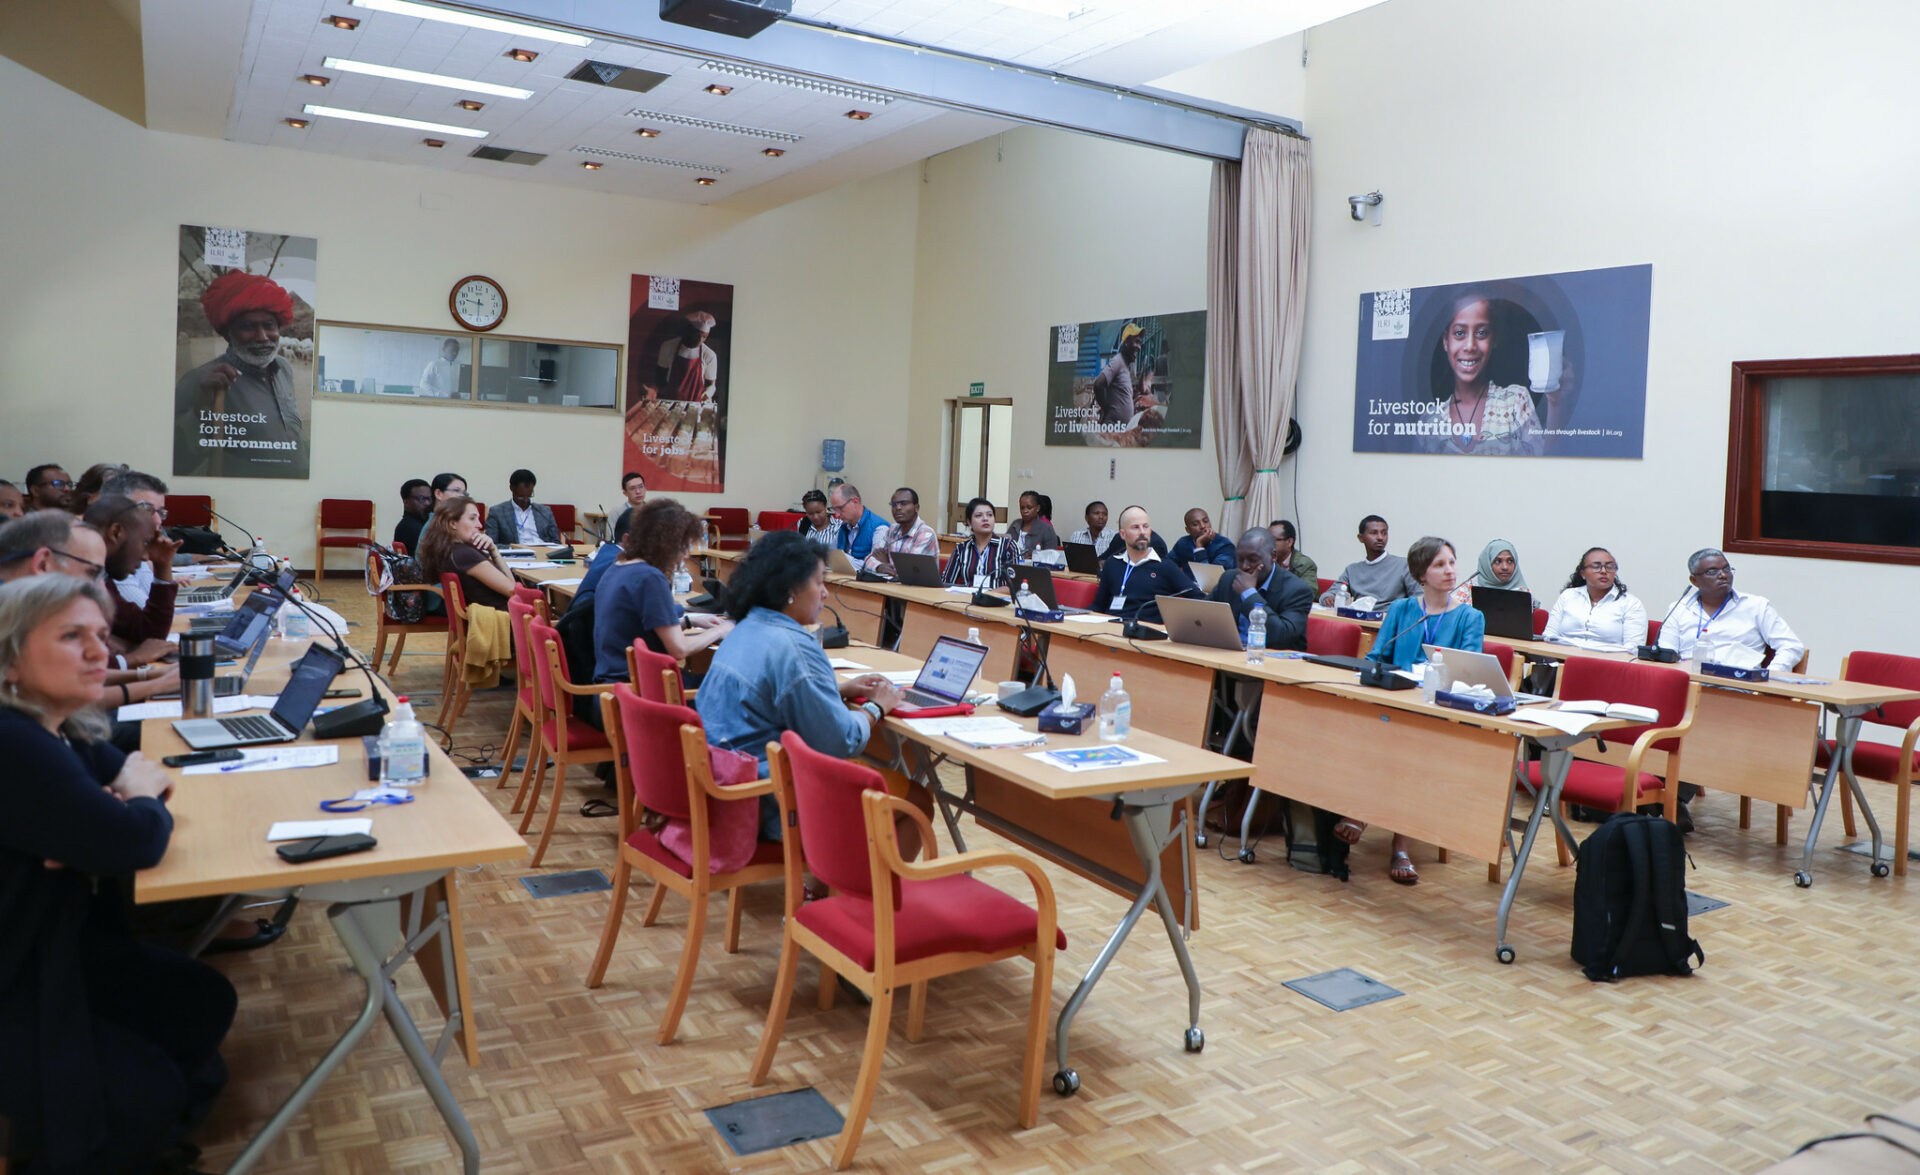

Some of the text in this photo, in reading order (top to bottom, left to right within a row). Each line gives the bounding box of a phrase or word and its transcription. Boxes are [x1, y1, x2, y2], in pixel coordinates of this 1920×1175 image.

[1376, 319, 1391, 328] ILRI
[1368, 398, 1447, 415] Livestock
[200, 410, 267, 423] Livestock
[199, 423, 248, 435] for the
[1054, 420, 1067, 433] for
[1068, 420, 1127, 433] livelihoods
[1367, 418, 1477, 436] for nutrition
[198, 437, 298, 450] environment
[642, 445, 685, 456] for jobs
